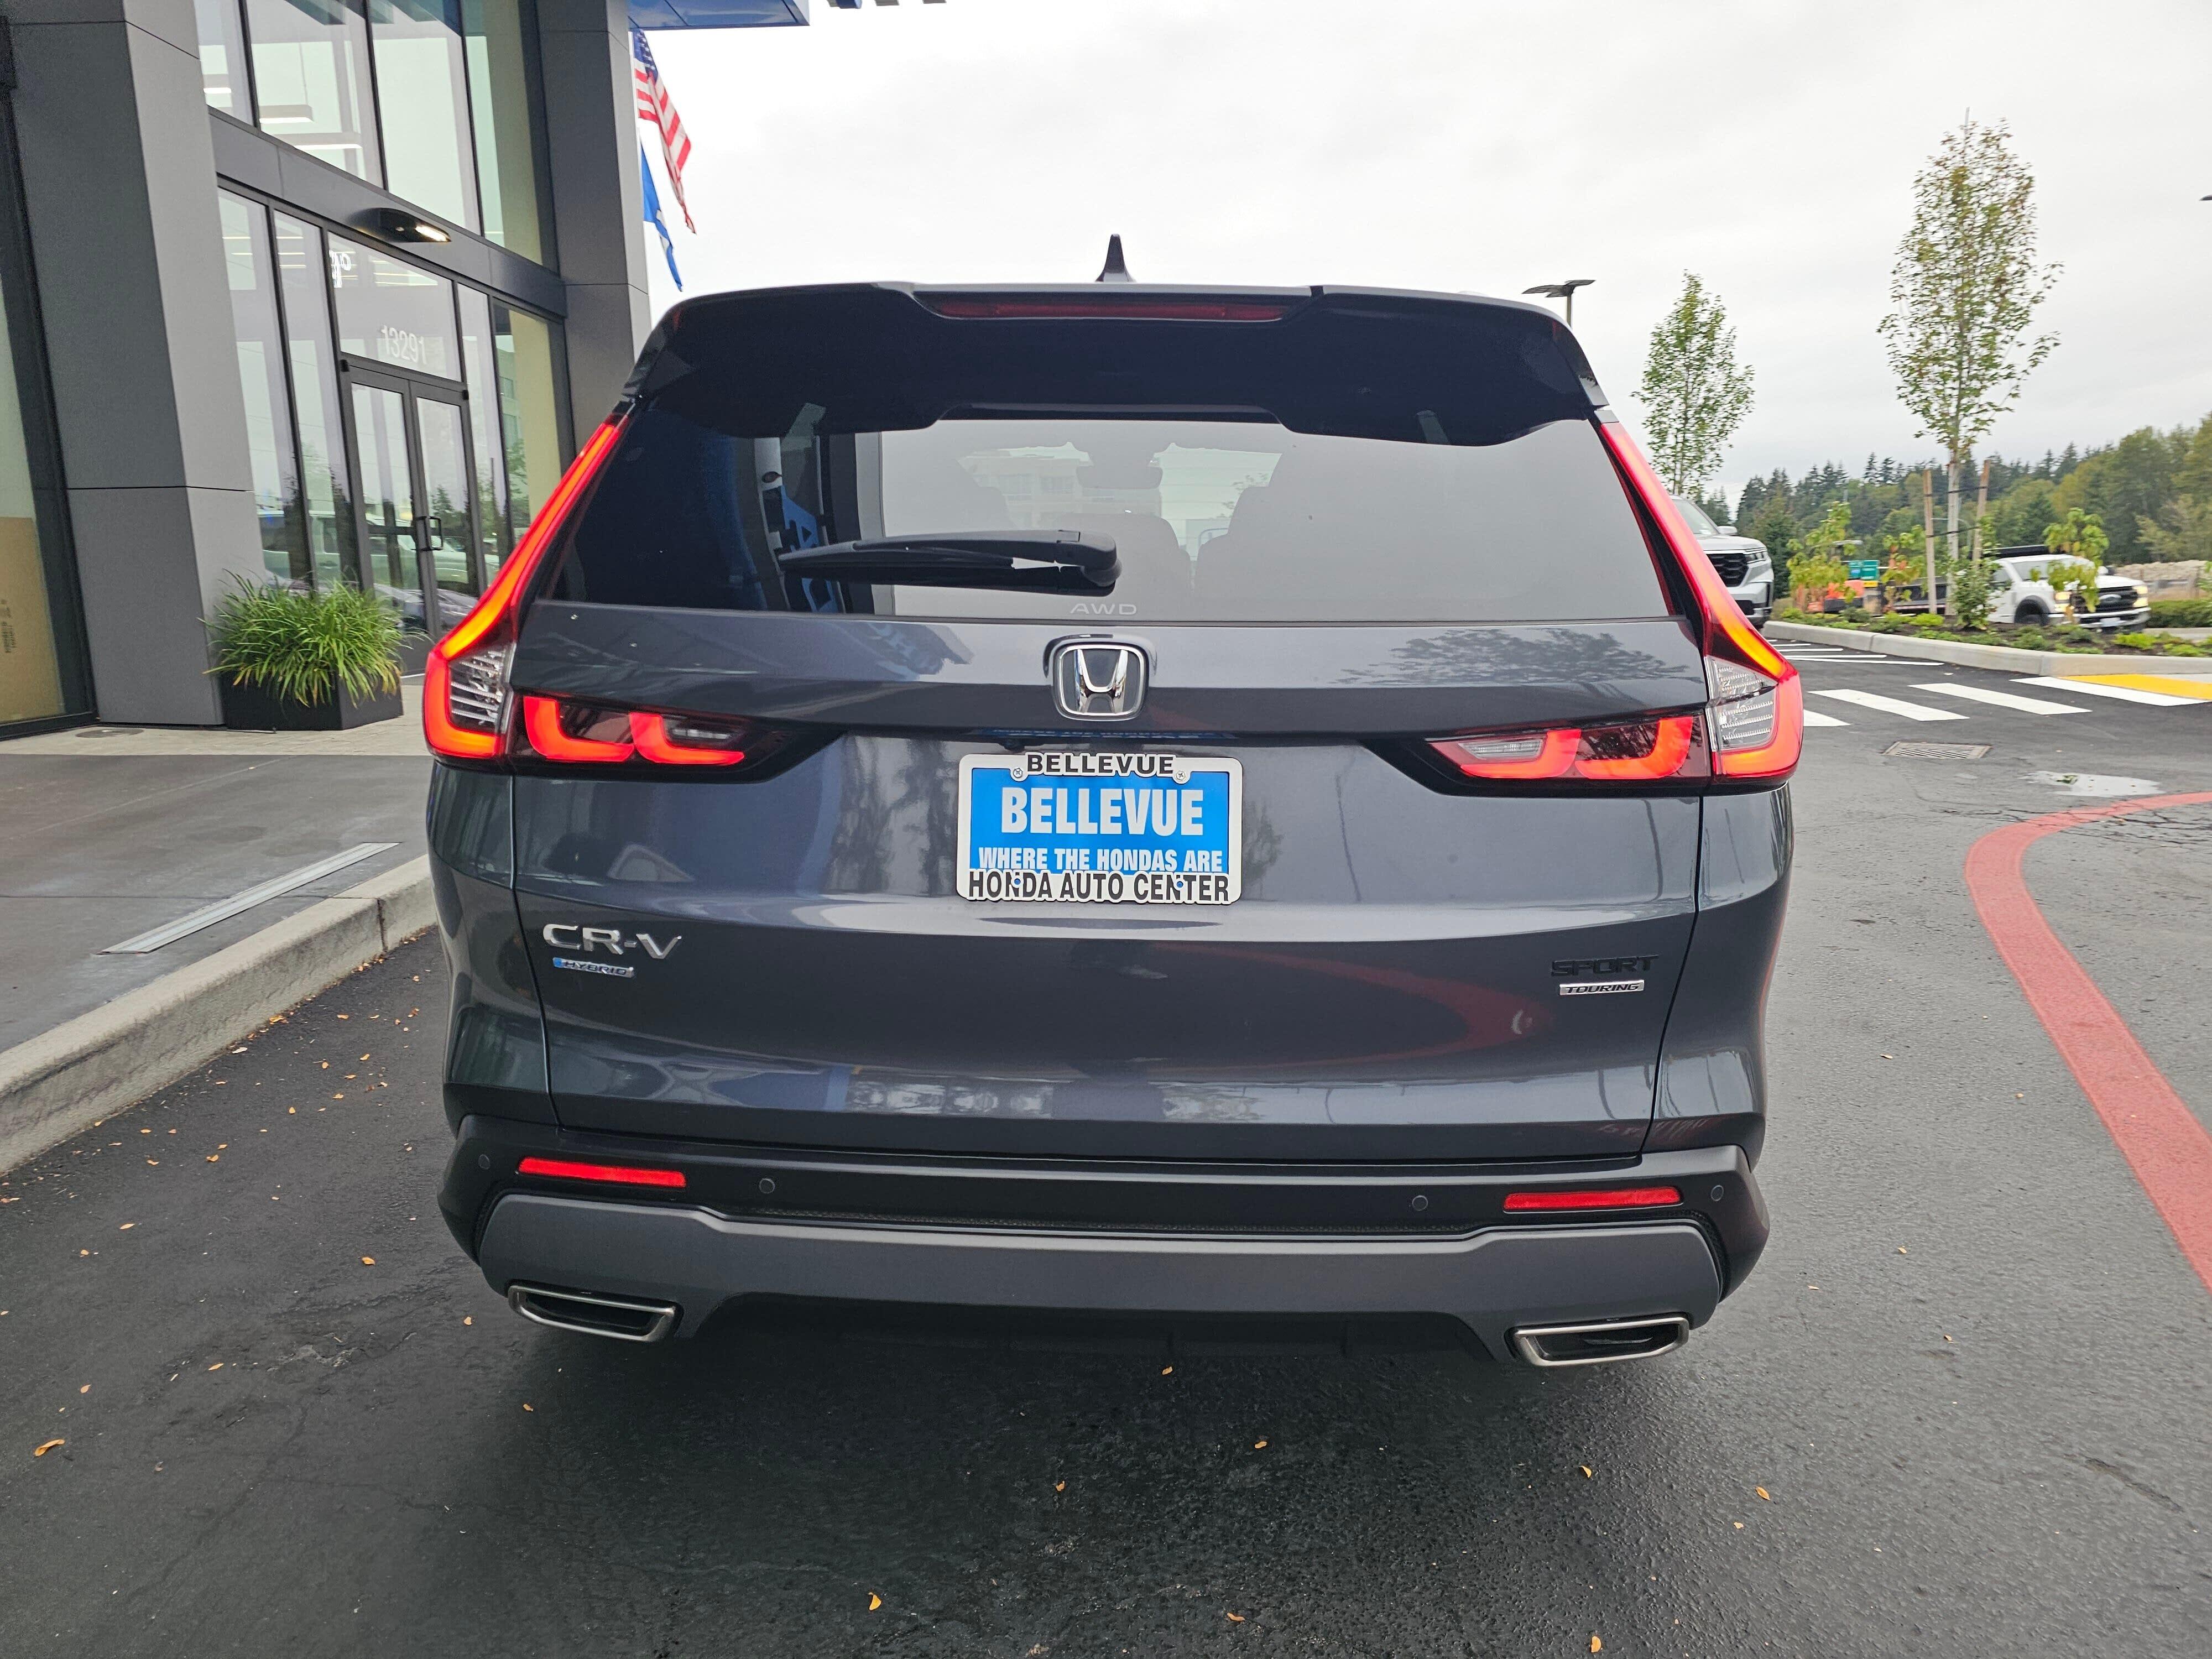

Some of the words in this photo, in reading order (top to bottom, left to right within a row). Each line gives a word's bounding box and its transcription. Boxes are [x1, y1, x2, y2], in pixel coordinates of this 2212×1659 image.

[380, 325, 426, 364] 13291
[1070, 603, 1137, 615] AWD
[1027, 755, 1174, 774] BELLEVUE
[1001, 787, 1204, 837] BELLEVUE
[979, 847, 1048, 870] WHERE
[1055, 848, 1090, 870] THE
[1099, 849, 1177, 872] HONDAS
[1183, 850, 1223, 872] ARE
[969, 871, 1051, 898] HONDA
[1060, 872, 1123, 900] AUTO
[1134, 873, 1228, 901] CENTER
[543, 924, 681, 959] CR-V
[564, 959, 627, 976] HYBRID
[1551, 954, 1658, 977] SPORT
[1565, 983, 1640, 994] TOURING
